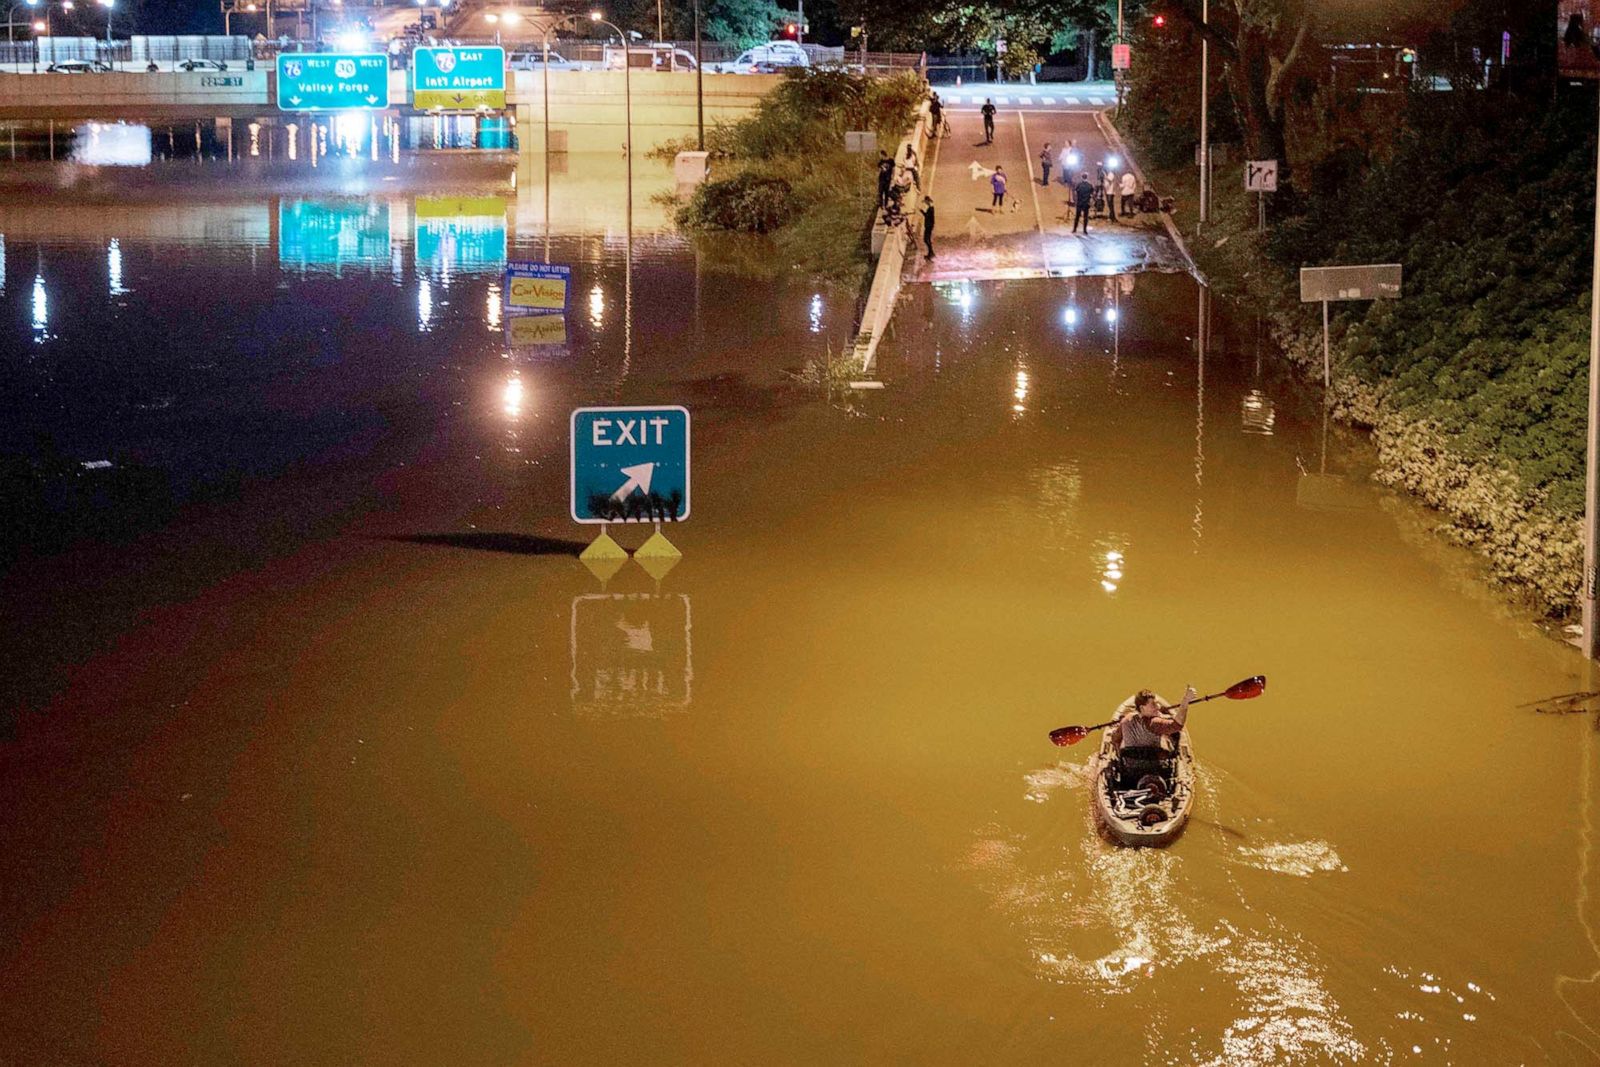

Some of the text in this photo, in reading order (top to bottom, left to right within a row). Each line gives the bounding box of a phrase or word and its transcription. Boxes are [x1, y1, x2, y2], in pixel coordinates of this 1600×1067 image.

[438, 52, 483, 68] 76 EAST
[287, 59, 383, 76] 76 WEST 30 WEST
[298, 83, 369, 94] Valley Forge
[425, 76, 493, 88] Int'l Airport
[508, 263, 570, 274] PLEASE DO NOT LITTER
[592, 419, 669, 446] EXIT
